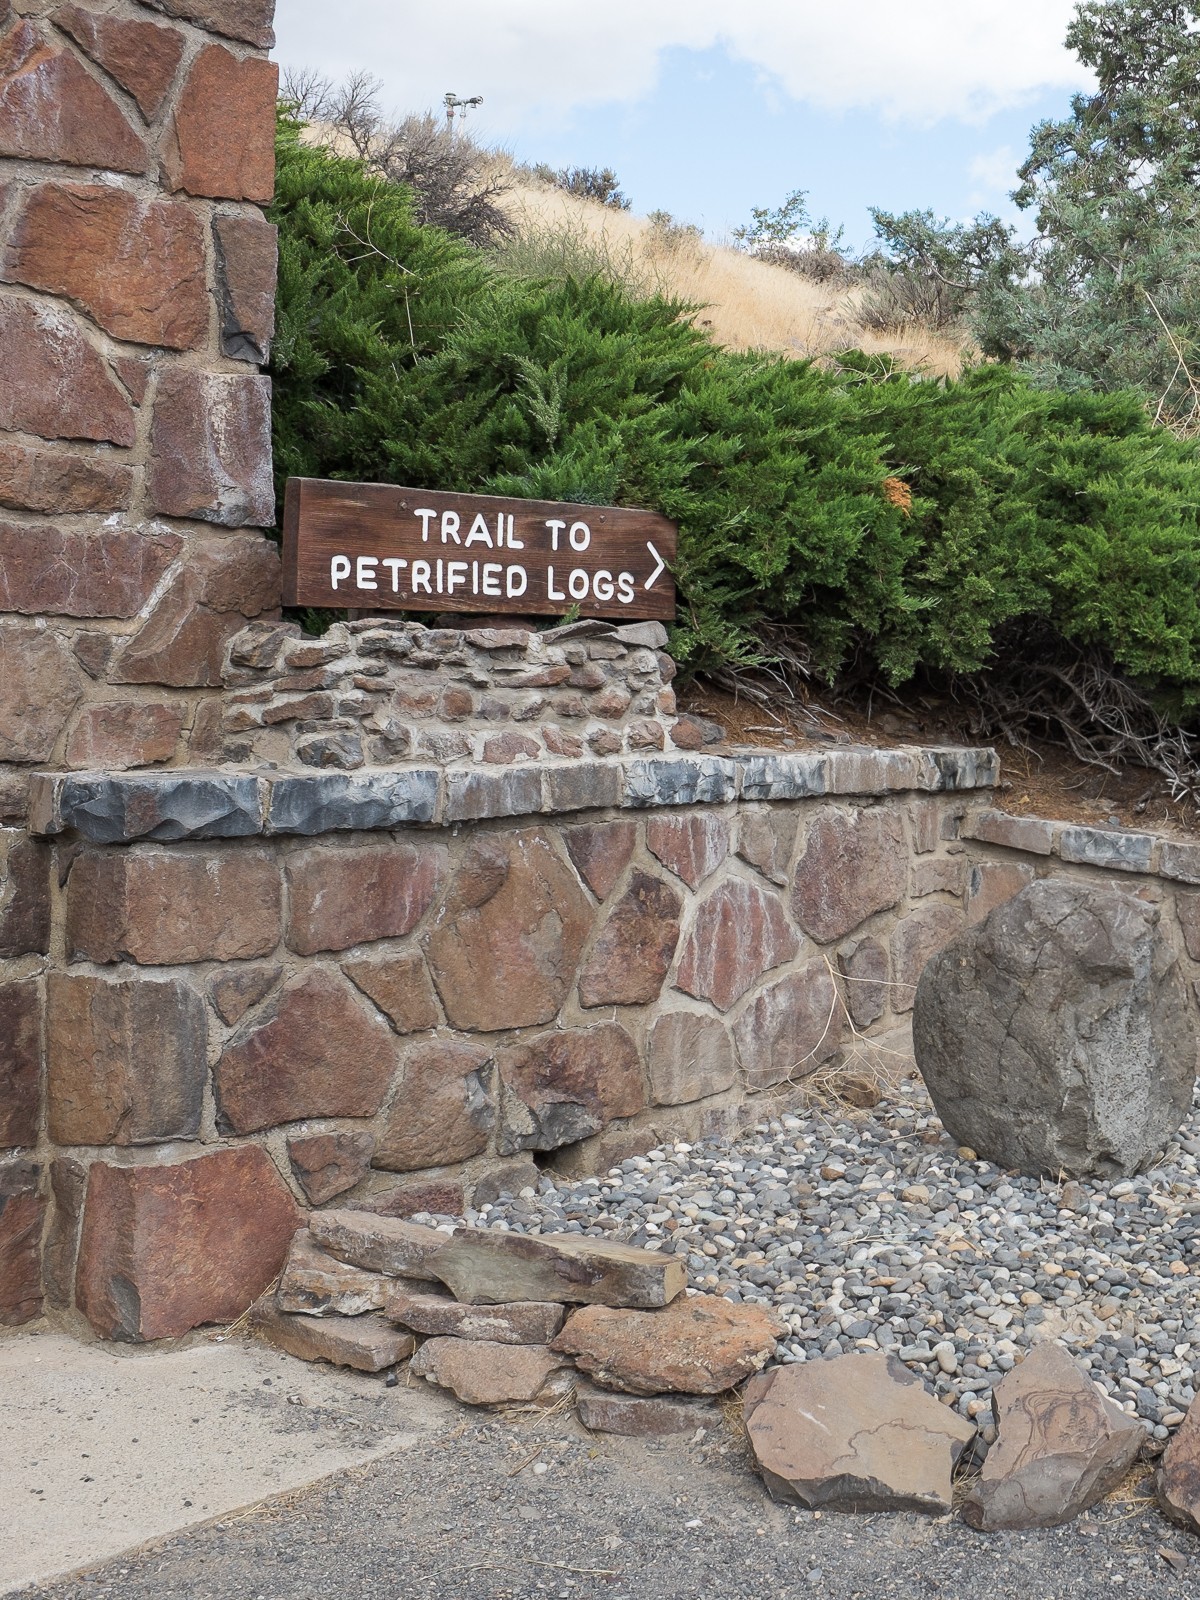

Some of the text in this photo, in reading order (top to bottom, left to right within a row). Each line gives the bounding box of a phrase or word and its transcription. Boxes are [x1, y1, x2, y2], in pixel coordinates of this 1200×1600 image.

[413, 508, 591, 552] TRAIL TO
[330, 555, 635, 604] PETRIFIED LOGS
